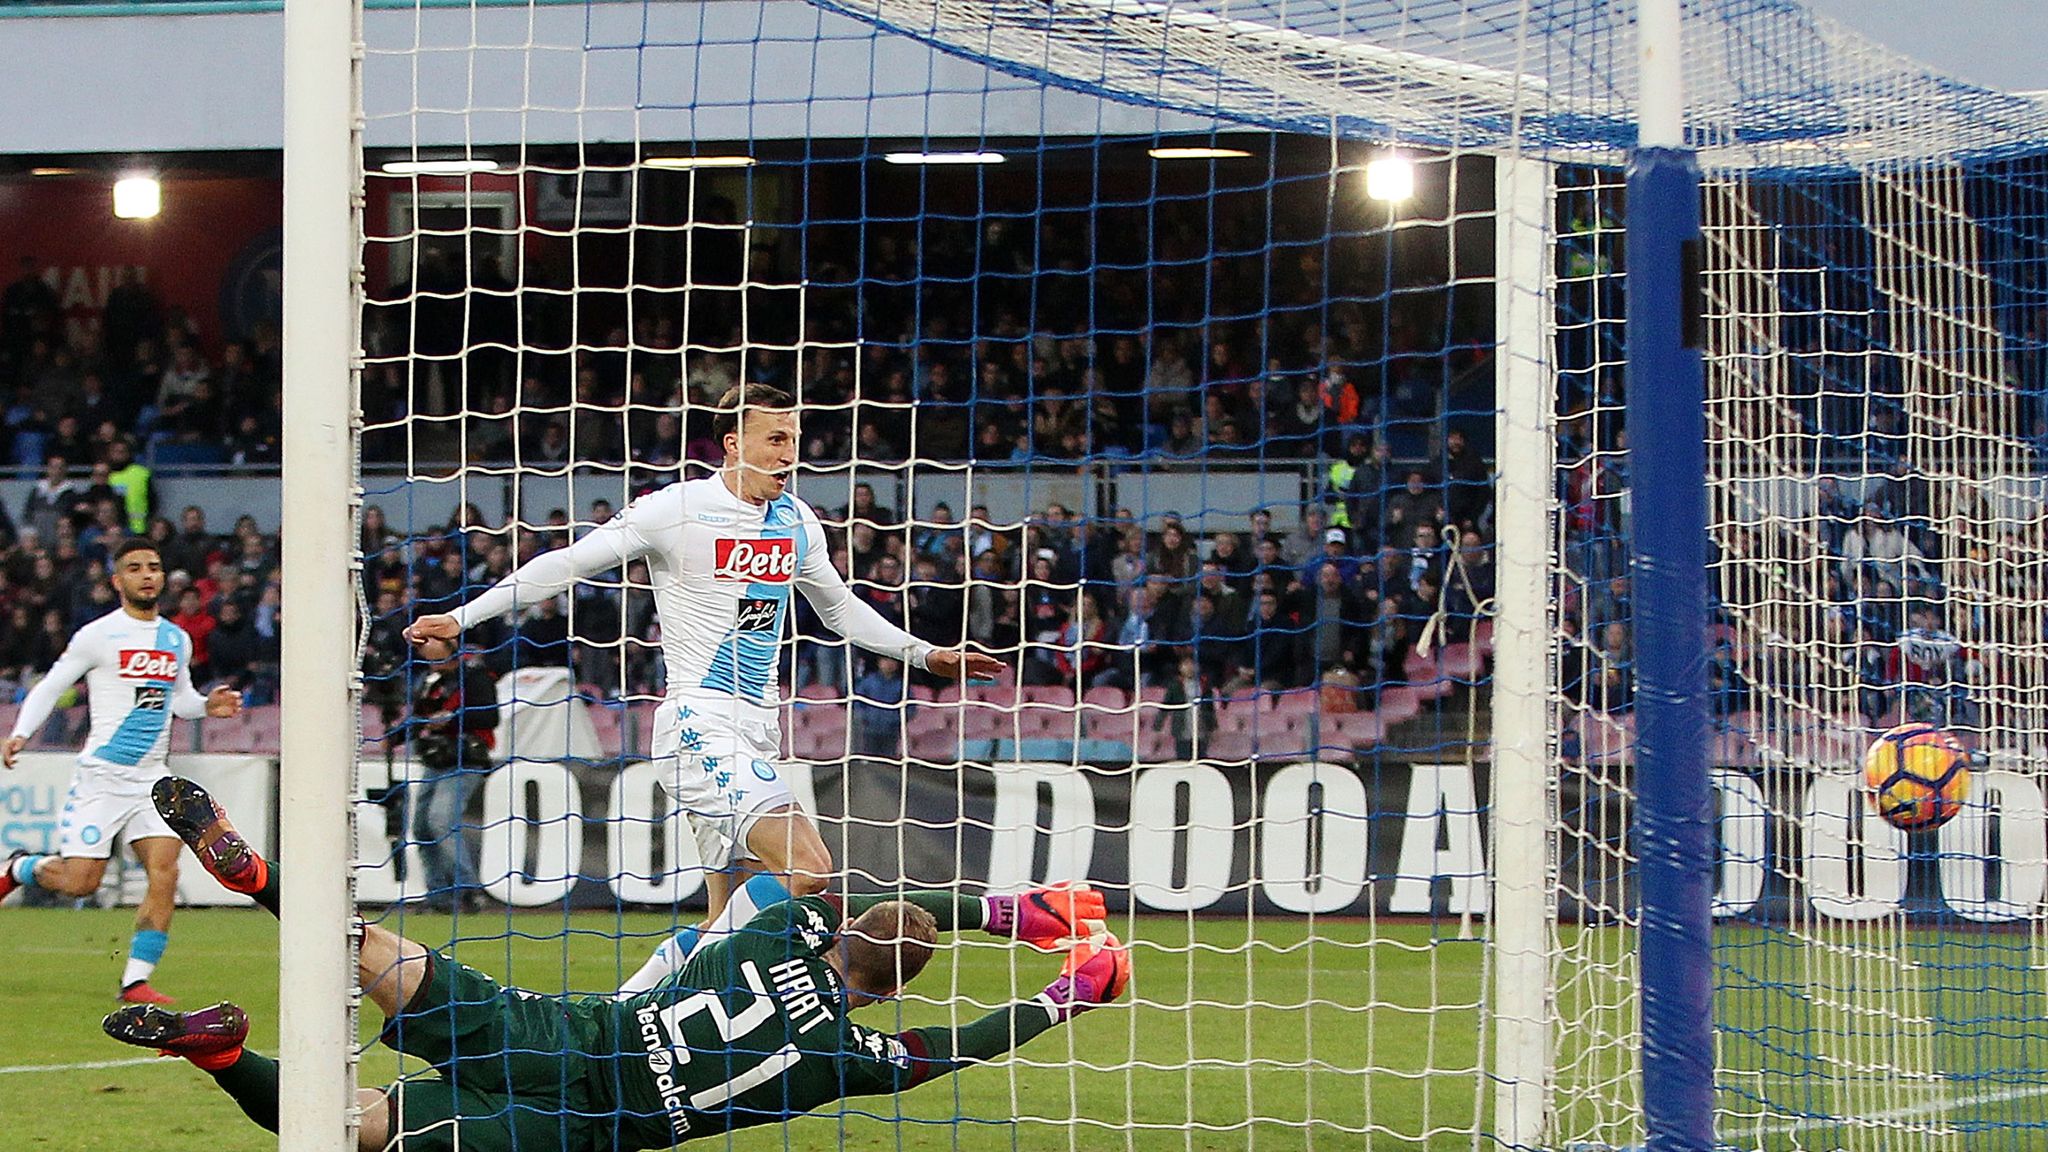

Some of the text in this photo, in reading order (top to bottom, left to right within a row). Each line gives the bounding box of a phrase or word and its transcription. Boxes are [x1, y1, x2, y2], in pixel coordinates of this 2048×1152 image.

[716, 543, 799, 578] Lete
[117, 651, 178, 678] Lete
[769, 958, 835, 1035] HART
[659, 960, 802, 1111] 21
